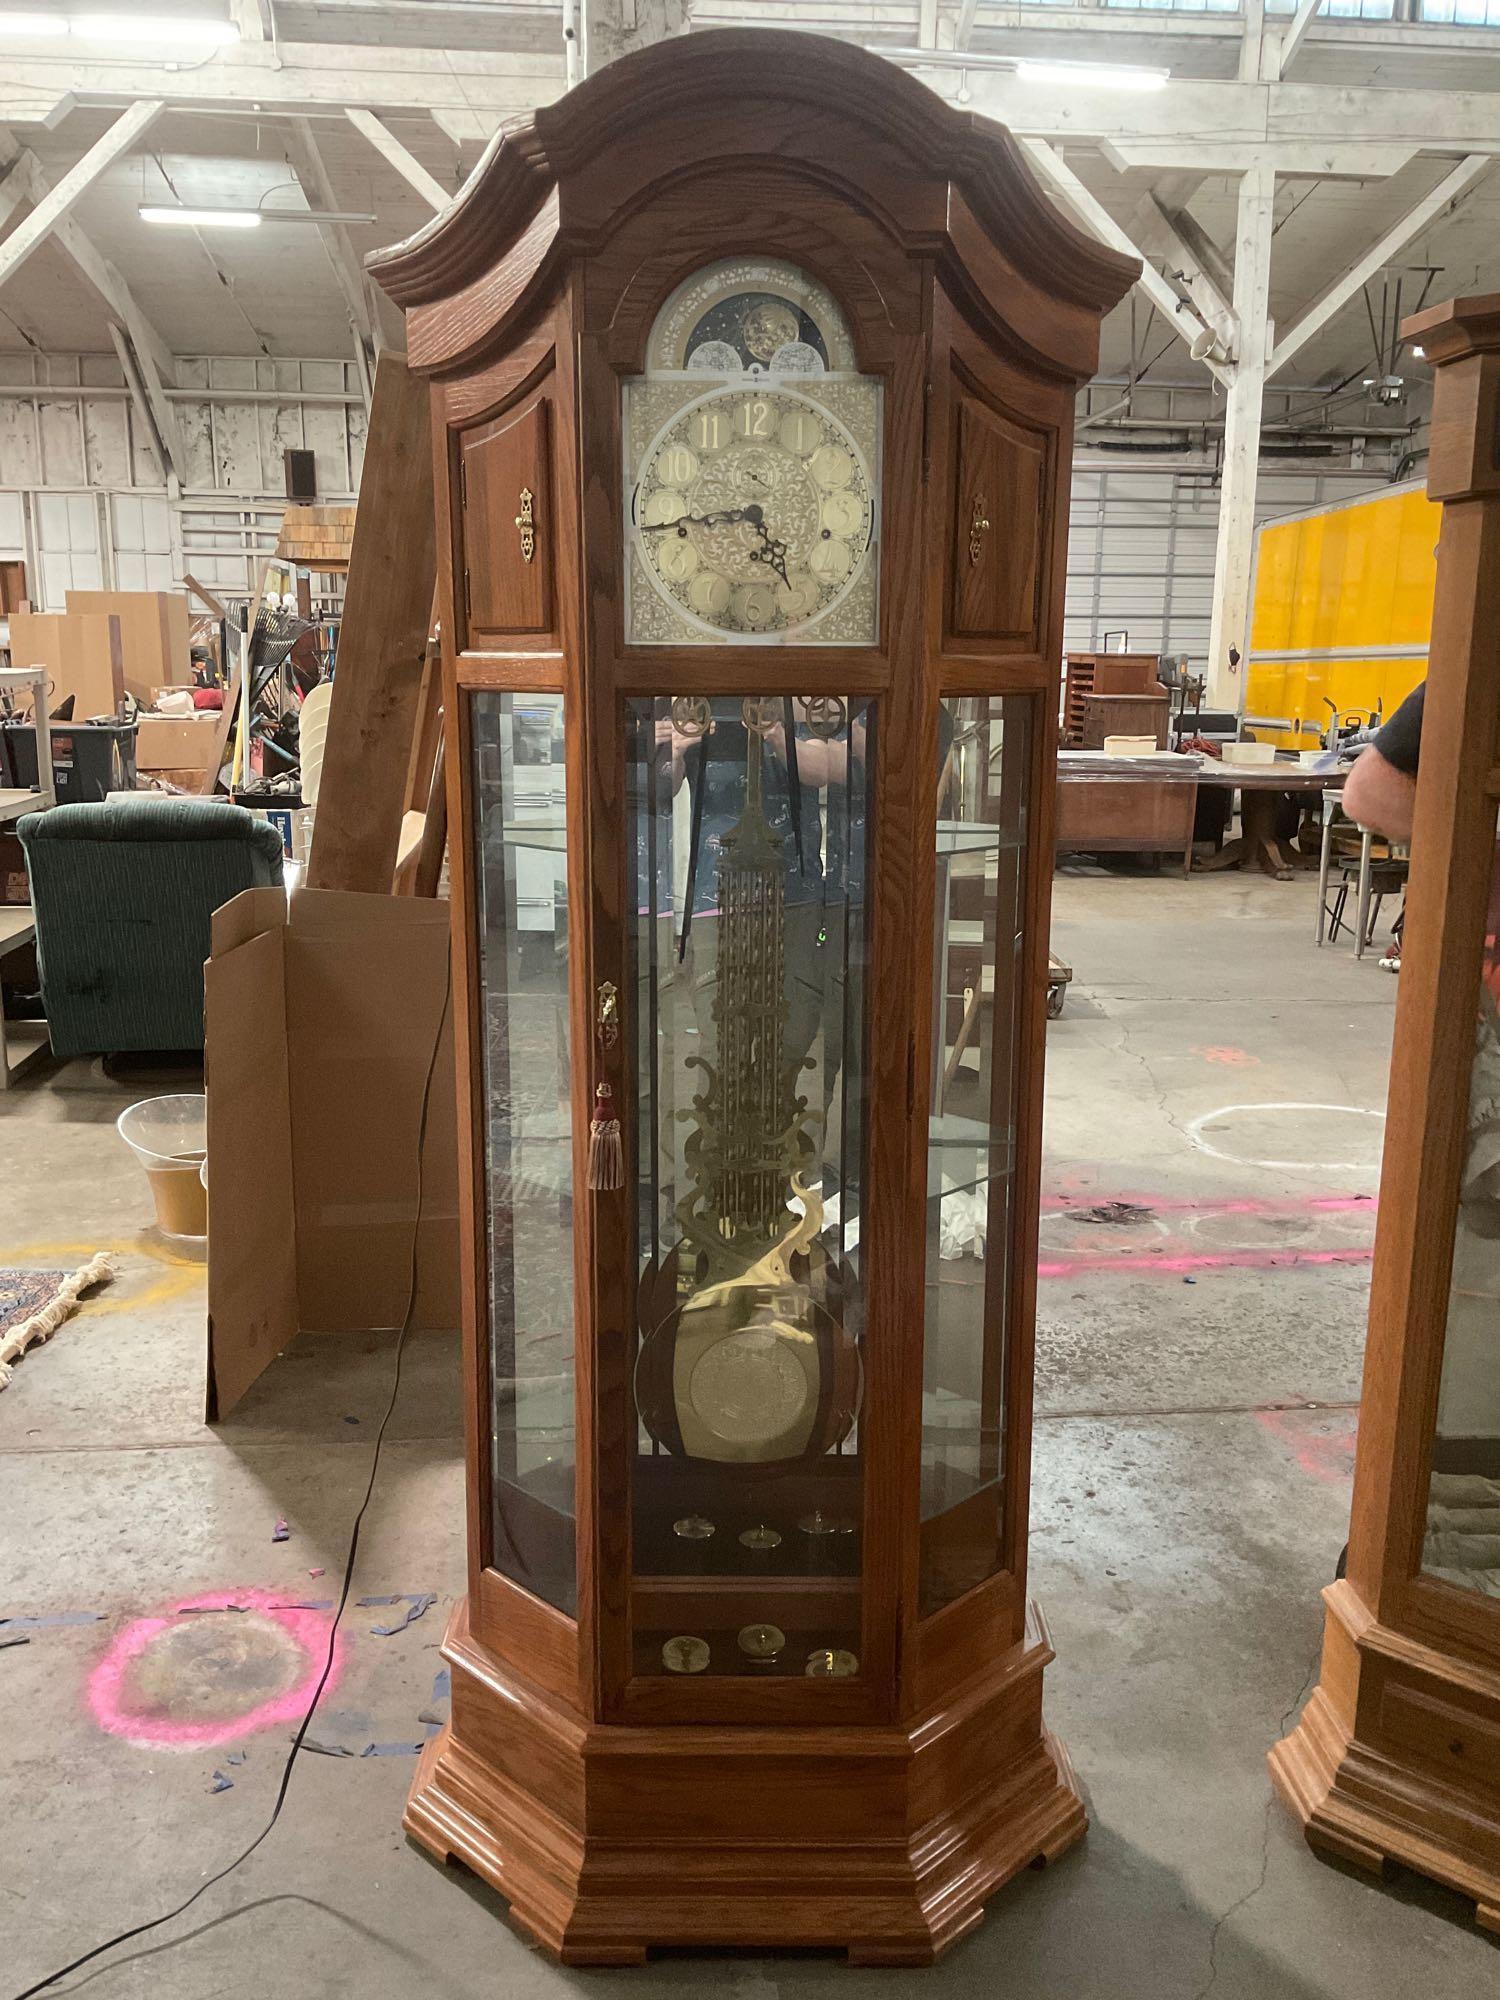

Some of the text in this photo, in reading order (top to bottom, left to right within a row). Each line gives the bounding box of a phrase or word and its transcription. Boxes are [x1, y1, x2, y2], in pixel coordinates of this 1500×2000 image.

[701, 414, 719, 449] 11
[743, 402, 768, 437] 12
[797, 417, 804, 450] 1
[666, 449, 691, 482] 10
[823, 449, 841, 484] 2
[657, 498, 673, 525] 9
[834, 499, 850, 532] 3
[668, 544, 686, 576] 8
[745, 588, 761, 622] 6
